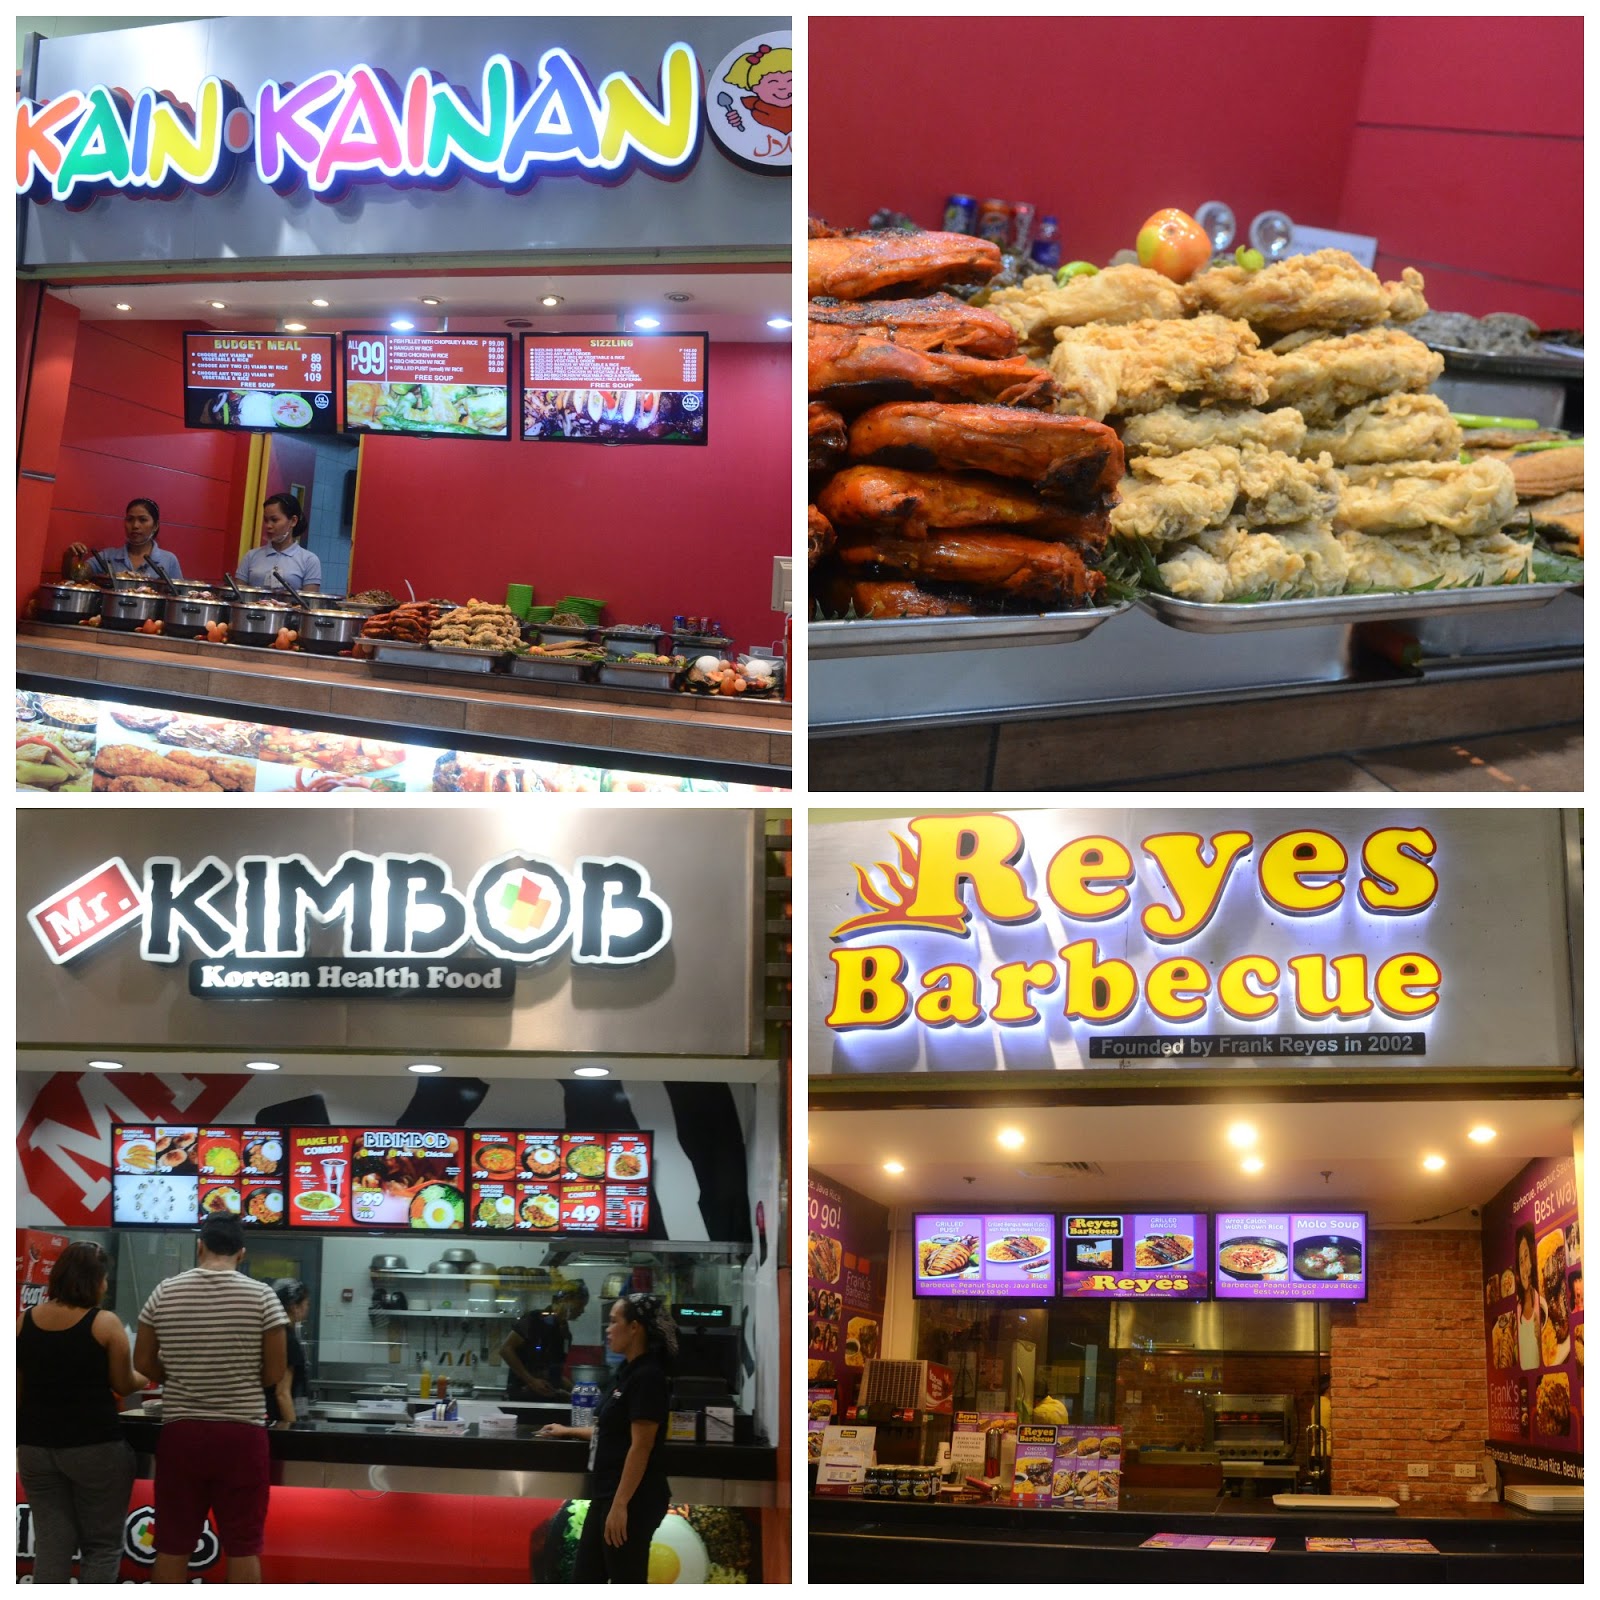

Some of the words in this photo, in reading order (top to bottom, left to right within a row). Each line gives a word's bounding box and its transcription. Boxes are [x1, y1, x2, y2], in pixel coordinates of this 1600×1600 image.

[16, 75, 222, 201] KAIN
[256, 42, 699, 191] KAINAN
[214, 339, 263, 350] BUDGET
[267, 340, 302, 351] MEAL
[348, 340, 359, 350] ALL
[590, 339, 634, 348] SIZZLING
[302, 353, 308, 361] P
[311, 353, 322, 362] 89
[358, 341, 385, 375] 99
[311, 362, 322, 372] 99
[304, 372, 322, 382] 109
[898, 812, 1441, 942] Reyes
[45, 888, 132, 946] Mr.
[143, 852, 669, 962] KIMBOB
[199, 965, 311, 990] Korean
[318, 966, 419, 990] Health
[427, 967, 503, 991] Food
[825, 939, 1443, 1030] Barbecue
[1101, 1038, 1185, 1057] Founded
[1190, 1037, 1212, 1057] by
[1220, 1037, 1273, 1054] Frank
[1279, 1036, 1338, 1056] Reyes
[1344, 1035, 1362, 1052] in
[1368, 1035, 1414, 1052] 2002
[296, 1137, 328, 1147] MAKE
[328, 1136, 340, 1144] IT
[340, 1135, 349, 1143] A
[363, 1132, 450, 1149] BIBIMBOB
[1534, 1191, 1555, 1225] Best
[1555, 1178, 1577, 1209] way
[820, 1204, 842, 1229] go!
[1075, 1218, 1118, 1229] Reyes
[1297, 1220, 1327, 1229] Molo
[1330, 1219, 1360, 1232] Soup
[1070, 1227, 1119, 1235] Barbecue
[1013, 1282, 1030, 1290] Java
[1091, 1275, 1190, 1294] Reyes
[996, 1289, 1009, 1297] go!
[1301, 1289, 1315, 1297] go!
[1490, 1379, 1520, 1403] Frank's
[1490, 1402, 1520, 1421] Barbecue
[1024, 1427, 1054, 1437] Reyes
[1020, 1435, 1054, 1443] Barbecue
